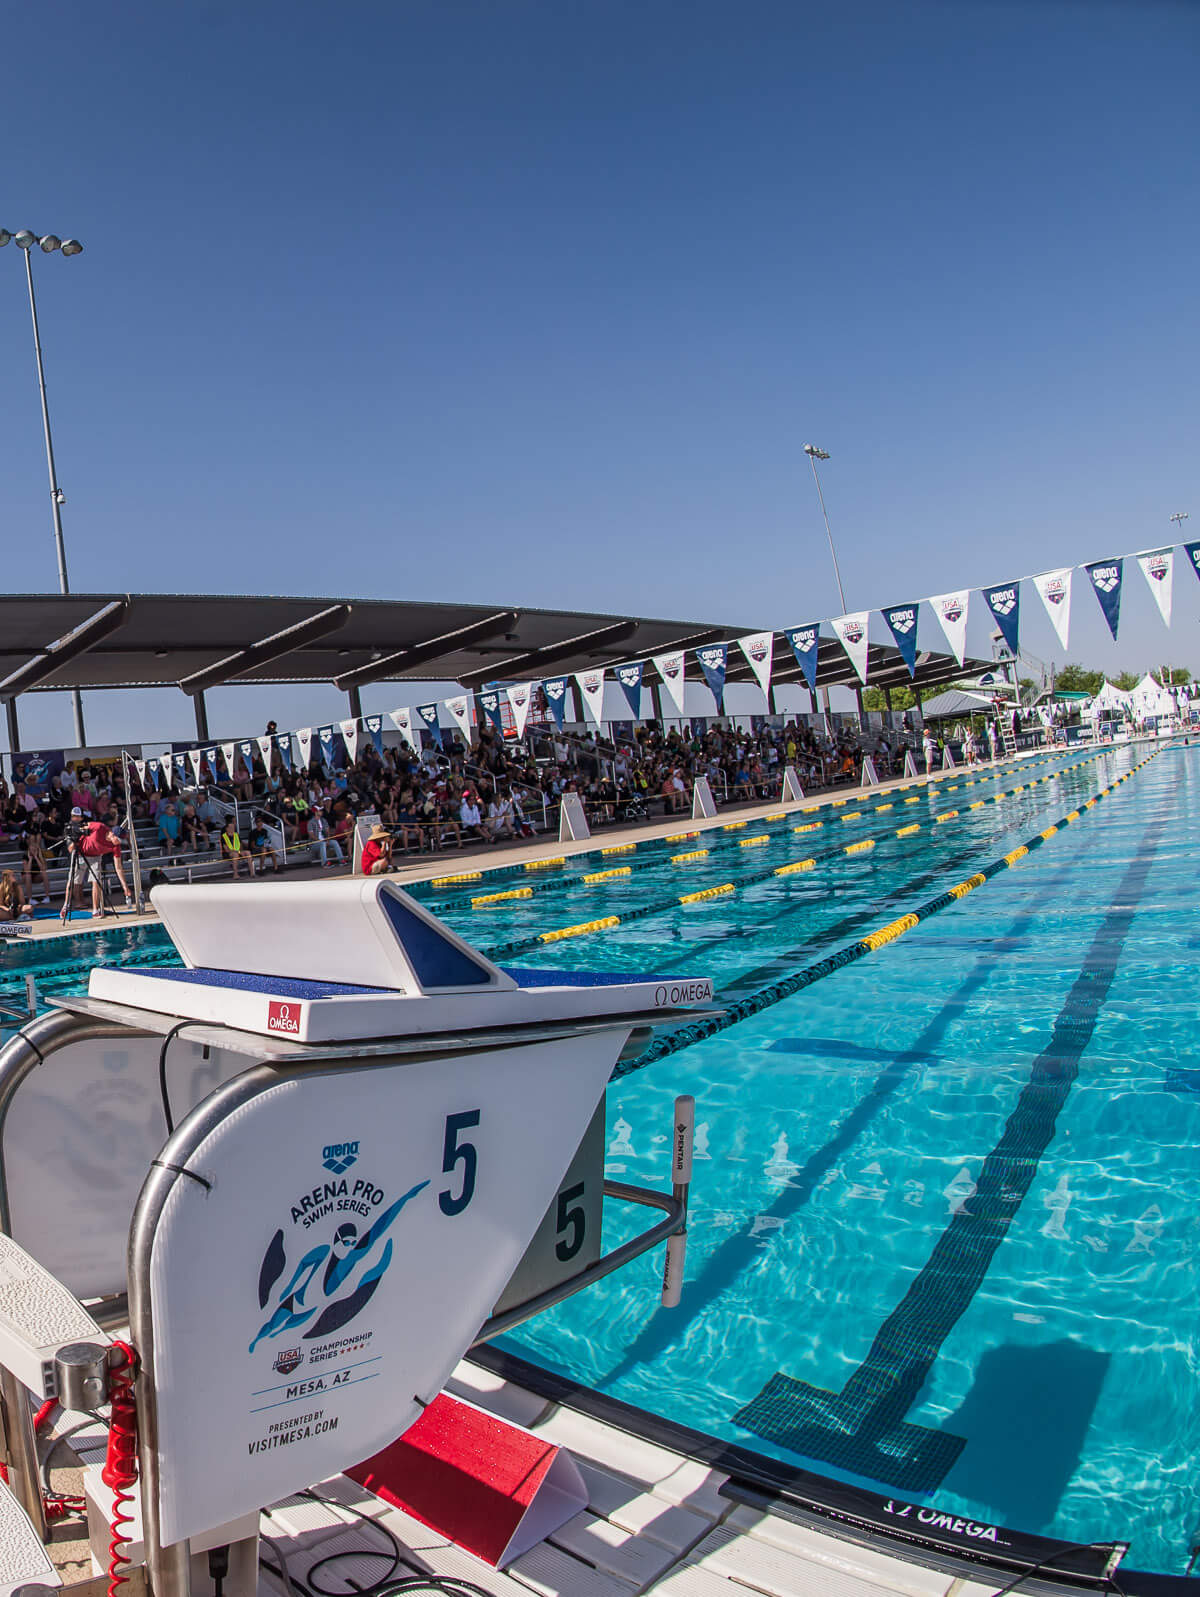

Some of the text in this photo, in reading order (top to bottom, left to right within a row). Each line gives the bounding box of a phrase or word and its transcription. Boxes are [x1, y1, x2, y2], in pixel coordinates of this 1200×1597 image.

[1092, 567, 1118, 580] arena
[1047, 580, 1062, 591] USA
[990, 589, 1015, 603] arena
[944, 600, 959, 610] USA
[890, 609, 914, 623] arena
[846, 623, 860, 632] USA
[792, 629, 815, 643] arena
[751, 642, 764, 651] USA
[702, 648, 723, 661] arena
[0, 926, 30, 935] OMEGA
[670, 983, 712, 1004] OMEGA
[269, 1017, 299, 1032] OMEGA
[322, 1141, 360, 1160] arena
[677, 1134, 685, 1170] PENTAIR
[438, 1108, 481, 1217] 5
[290, 1179, 385, 1224] ARENA PRO
[302, 1199, 372, 1229] SWIM SERIES
[555, 1181, 586, 1263] 5
[310, 1331, 373, 1356] CHAMPIONSHIP
[280, 1350, 298, 1362] USA
[309, 1350, 338, 1364] SERIES
[286, 1370, 351, 1399] MESA, AZ
[269, 1410, 324, 1434] PRESENTED BY
[248, 1417, 339, 1456] VISITMESA.COM
[917, 1509, 998, 1543] OMEGA
